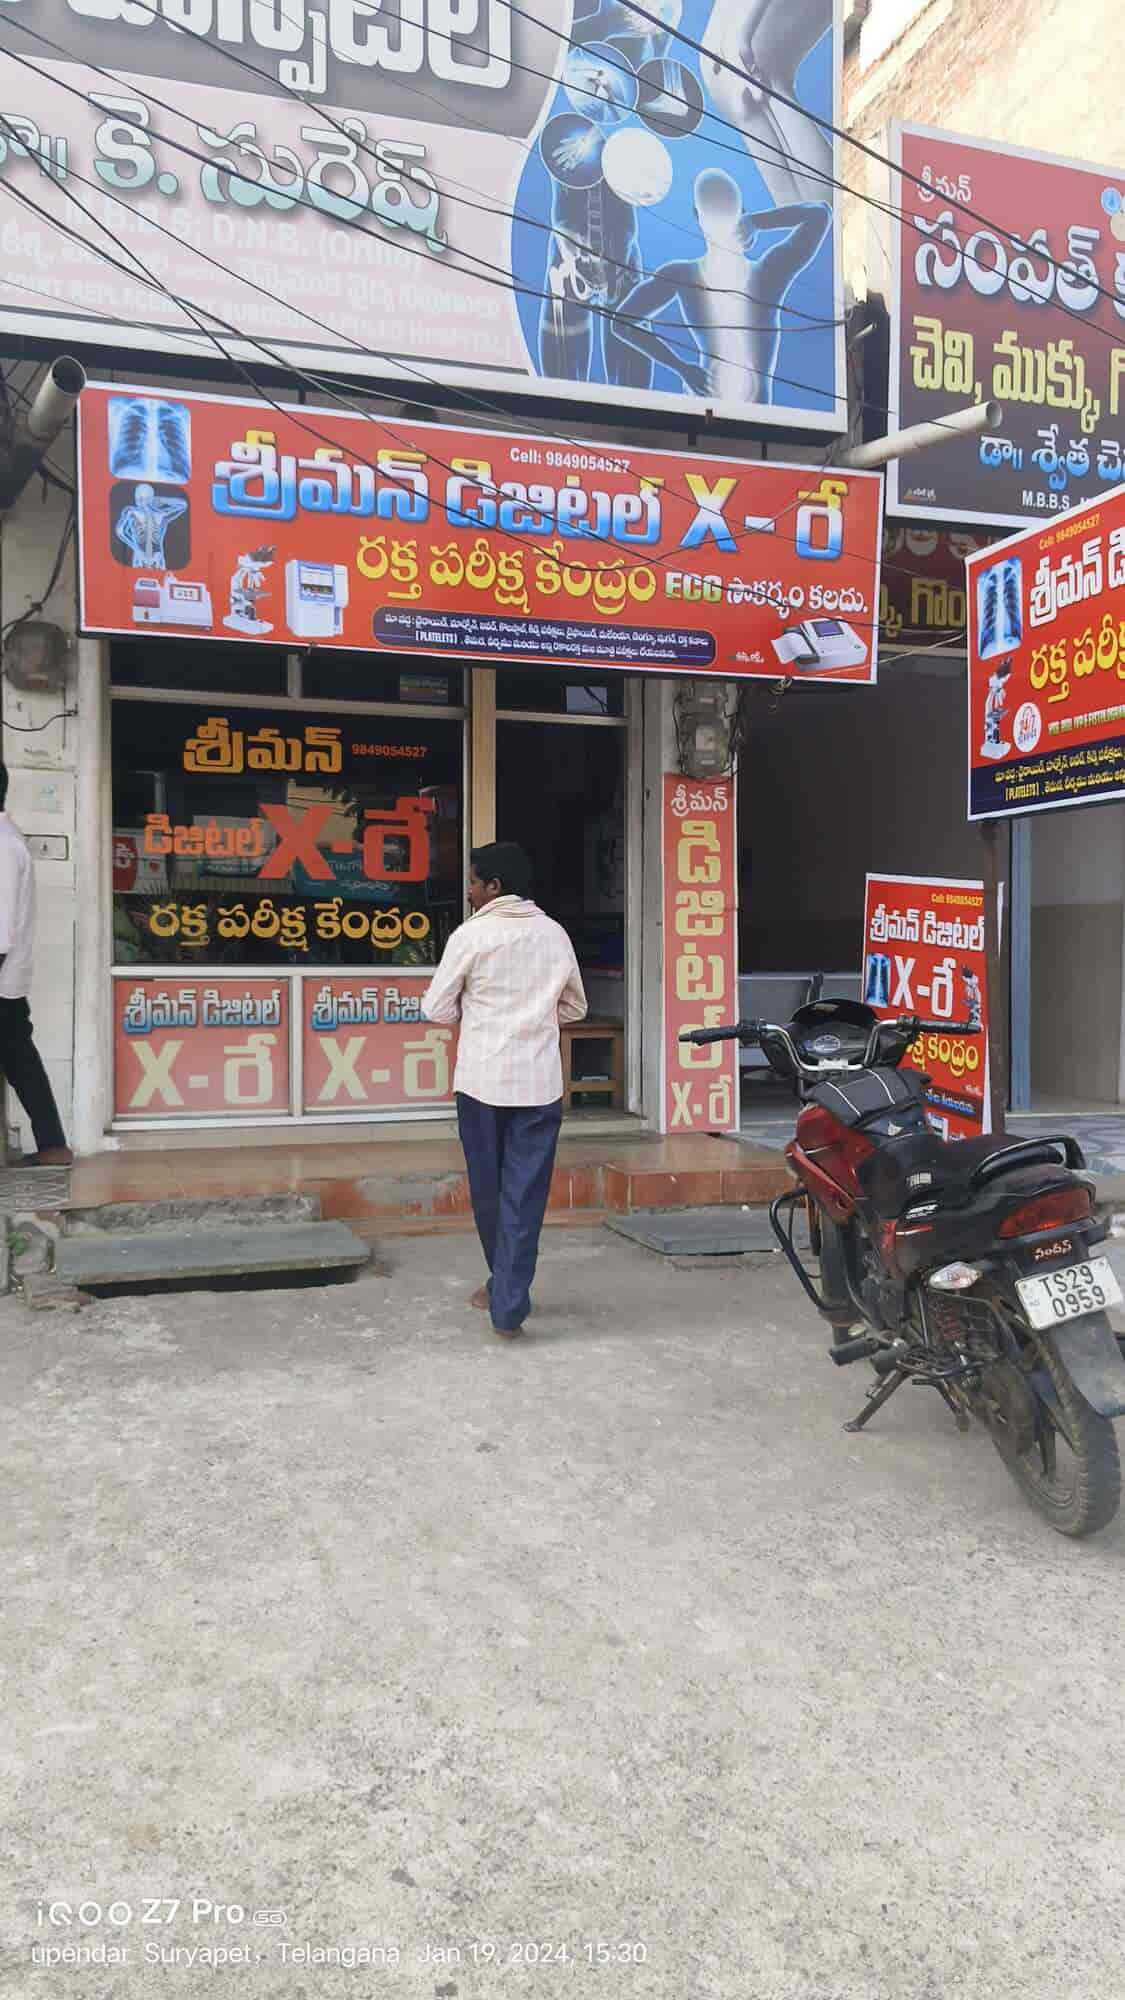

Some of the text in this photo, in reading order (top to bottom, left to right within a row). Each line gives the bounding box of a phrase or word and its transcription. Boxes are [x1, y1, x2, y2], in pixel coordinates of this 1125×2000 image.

[912, 210, 1101, 313] సంపత్
[510, 447, 632, 474] Cell: 9849054527
[211, 429, 430, 522] శ్రీమన్
[446, 457, 665, 545] డిజిటల్
[355, 535, 422, 600] రక్త
[429, 537, 531, 614] పరీక్ష
[533, 539, 658, 615] కేంద్రం
[665, 570, 722, 604] ECG
[1029, 535, 1102, 628] శ్రీమన్
[1030, 637, 1070, 704] రక్త
[183, 716, 428, 774] శ్రీమన్ 9849054527
[671, 783, 729, 817] శ్రీమన్
[149, 896, 431, 952] రక్త పరీక్ష కేంద్రం
[870, 903, 921, 943] శ్రీమన్
[123, 986, 197, 1034] శ్రీమన్
[310, 983, 379, 1032] శ్రీమన్
[1038, 1264, 1095, 1299] TS29
[1051, 1284, 1107, 1319] 0959
